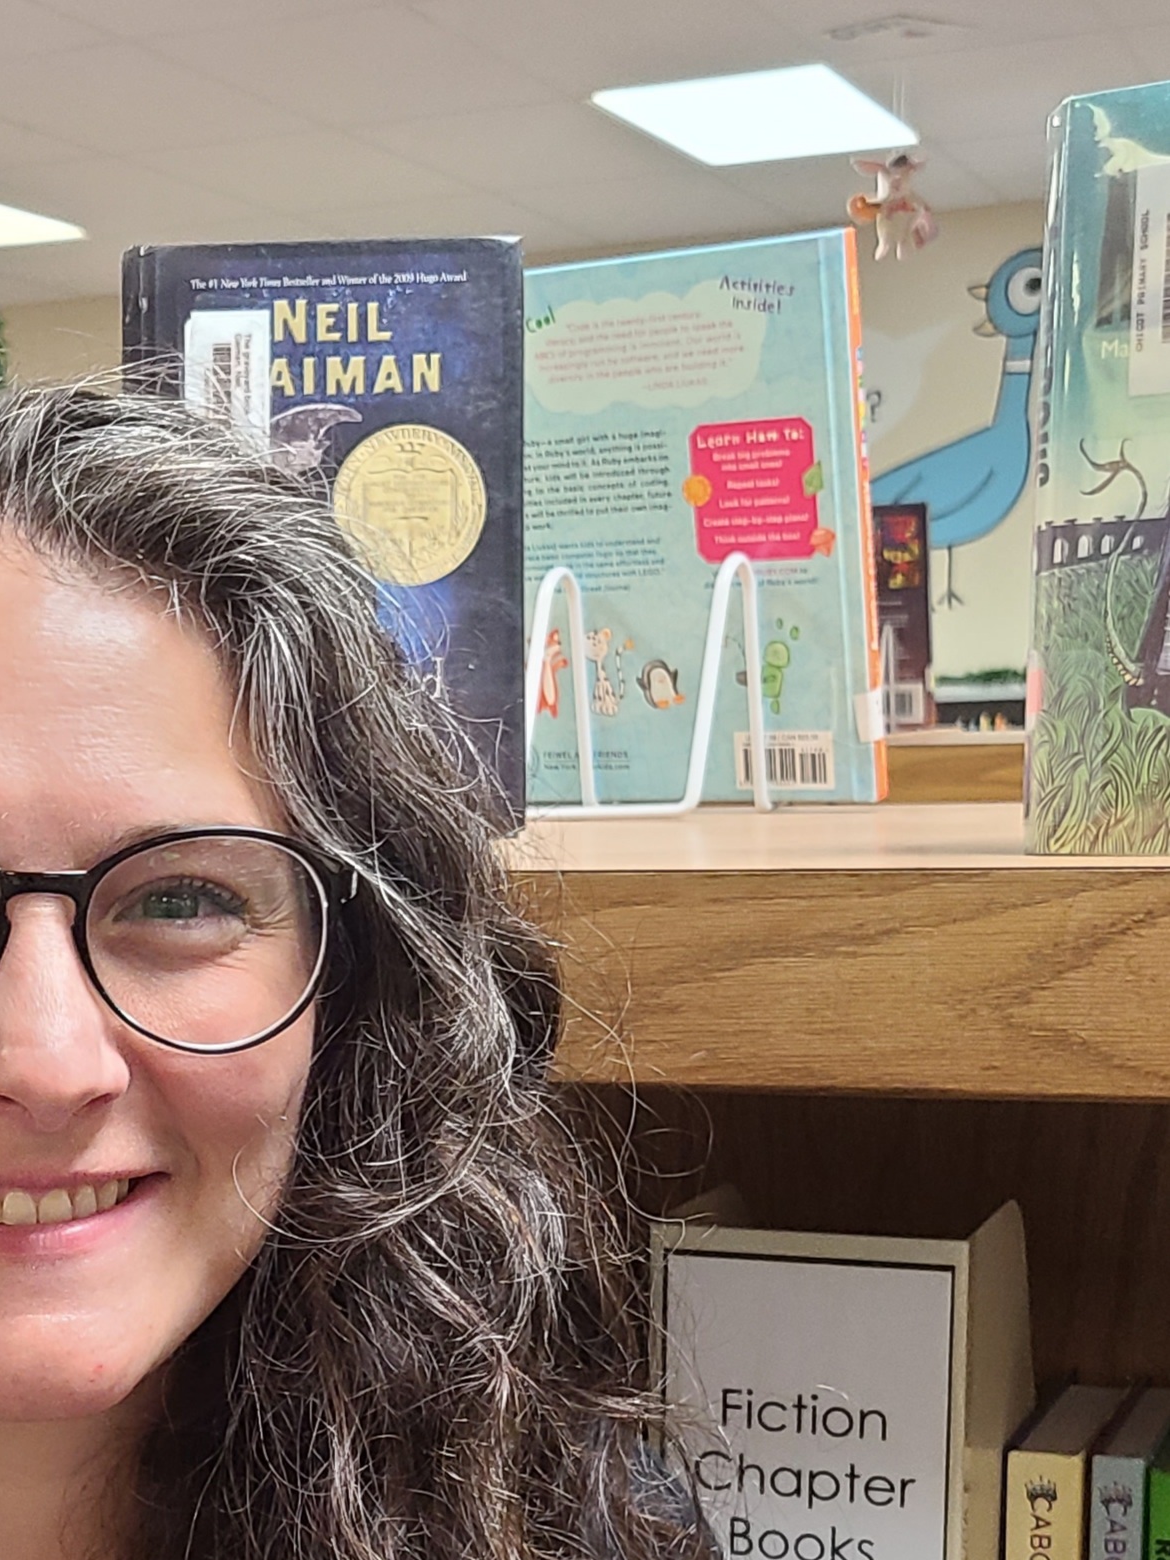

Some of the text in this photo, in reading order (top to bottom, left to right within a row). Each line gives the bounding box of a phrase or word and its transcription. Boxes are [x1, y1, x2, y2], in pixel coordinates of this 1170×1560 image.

[1140, 208, 1150, 251] SCHOOL
[190, 279, 207, 290] The
[220, 278, 239, 289] New
[240, 277, 258, 288] York
[258, 276, 281, 288] Times
[282, 275, 320, 287] Bestseller
[321, 274, 336, 286] and
[337, 274, 367, 286] Winner
[368, 273, 378, 284] of
[378, 273, 393, 285] the
[416, 272, 439, 285] Hugo
[440, 270, 467, 282] Award
[719, 275, 795, 297] Activities
[1137, 257, 1147, 306] PRIMARY
[273, 299, 393, 343] NEIL
[525, 305, 556, 333] Cool
[732, 298, 781, 314] Inside!
[270, 353, 442, 396] AIMAN
[697, 435, 741, 449] Learn
[745, 429, 779, 444] How
[721, 1388, 887, 1441] Fiction
[694, 1450, 917, 1509] Chapter
